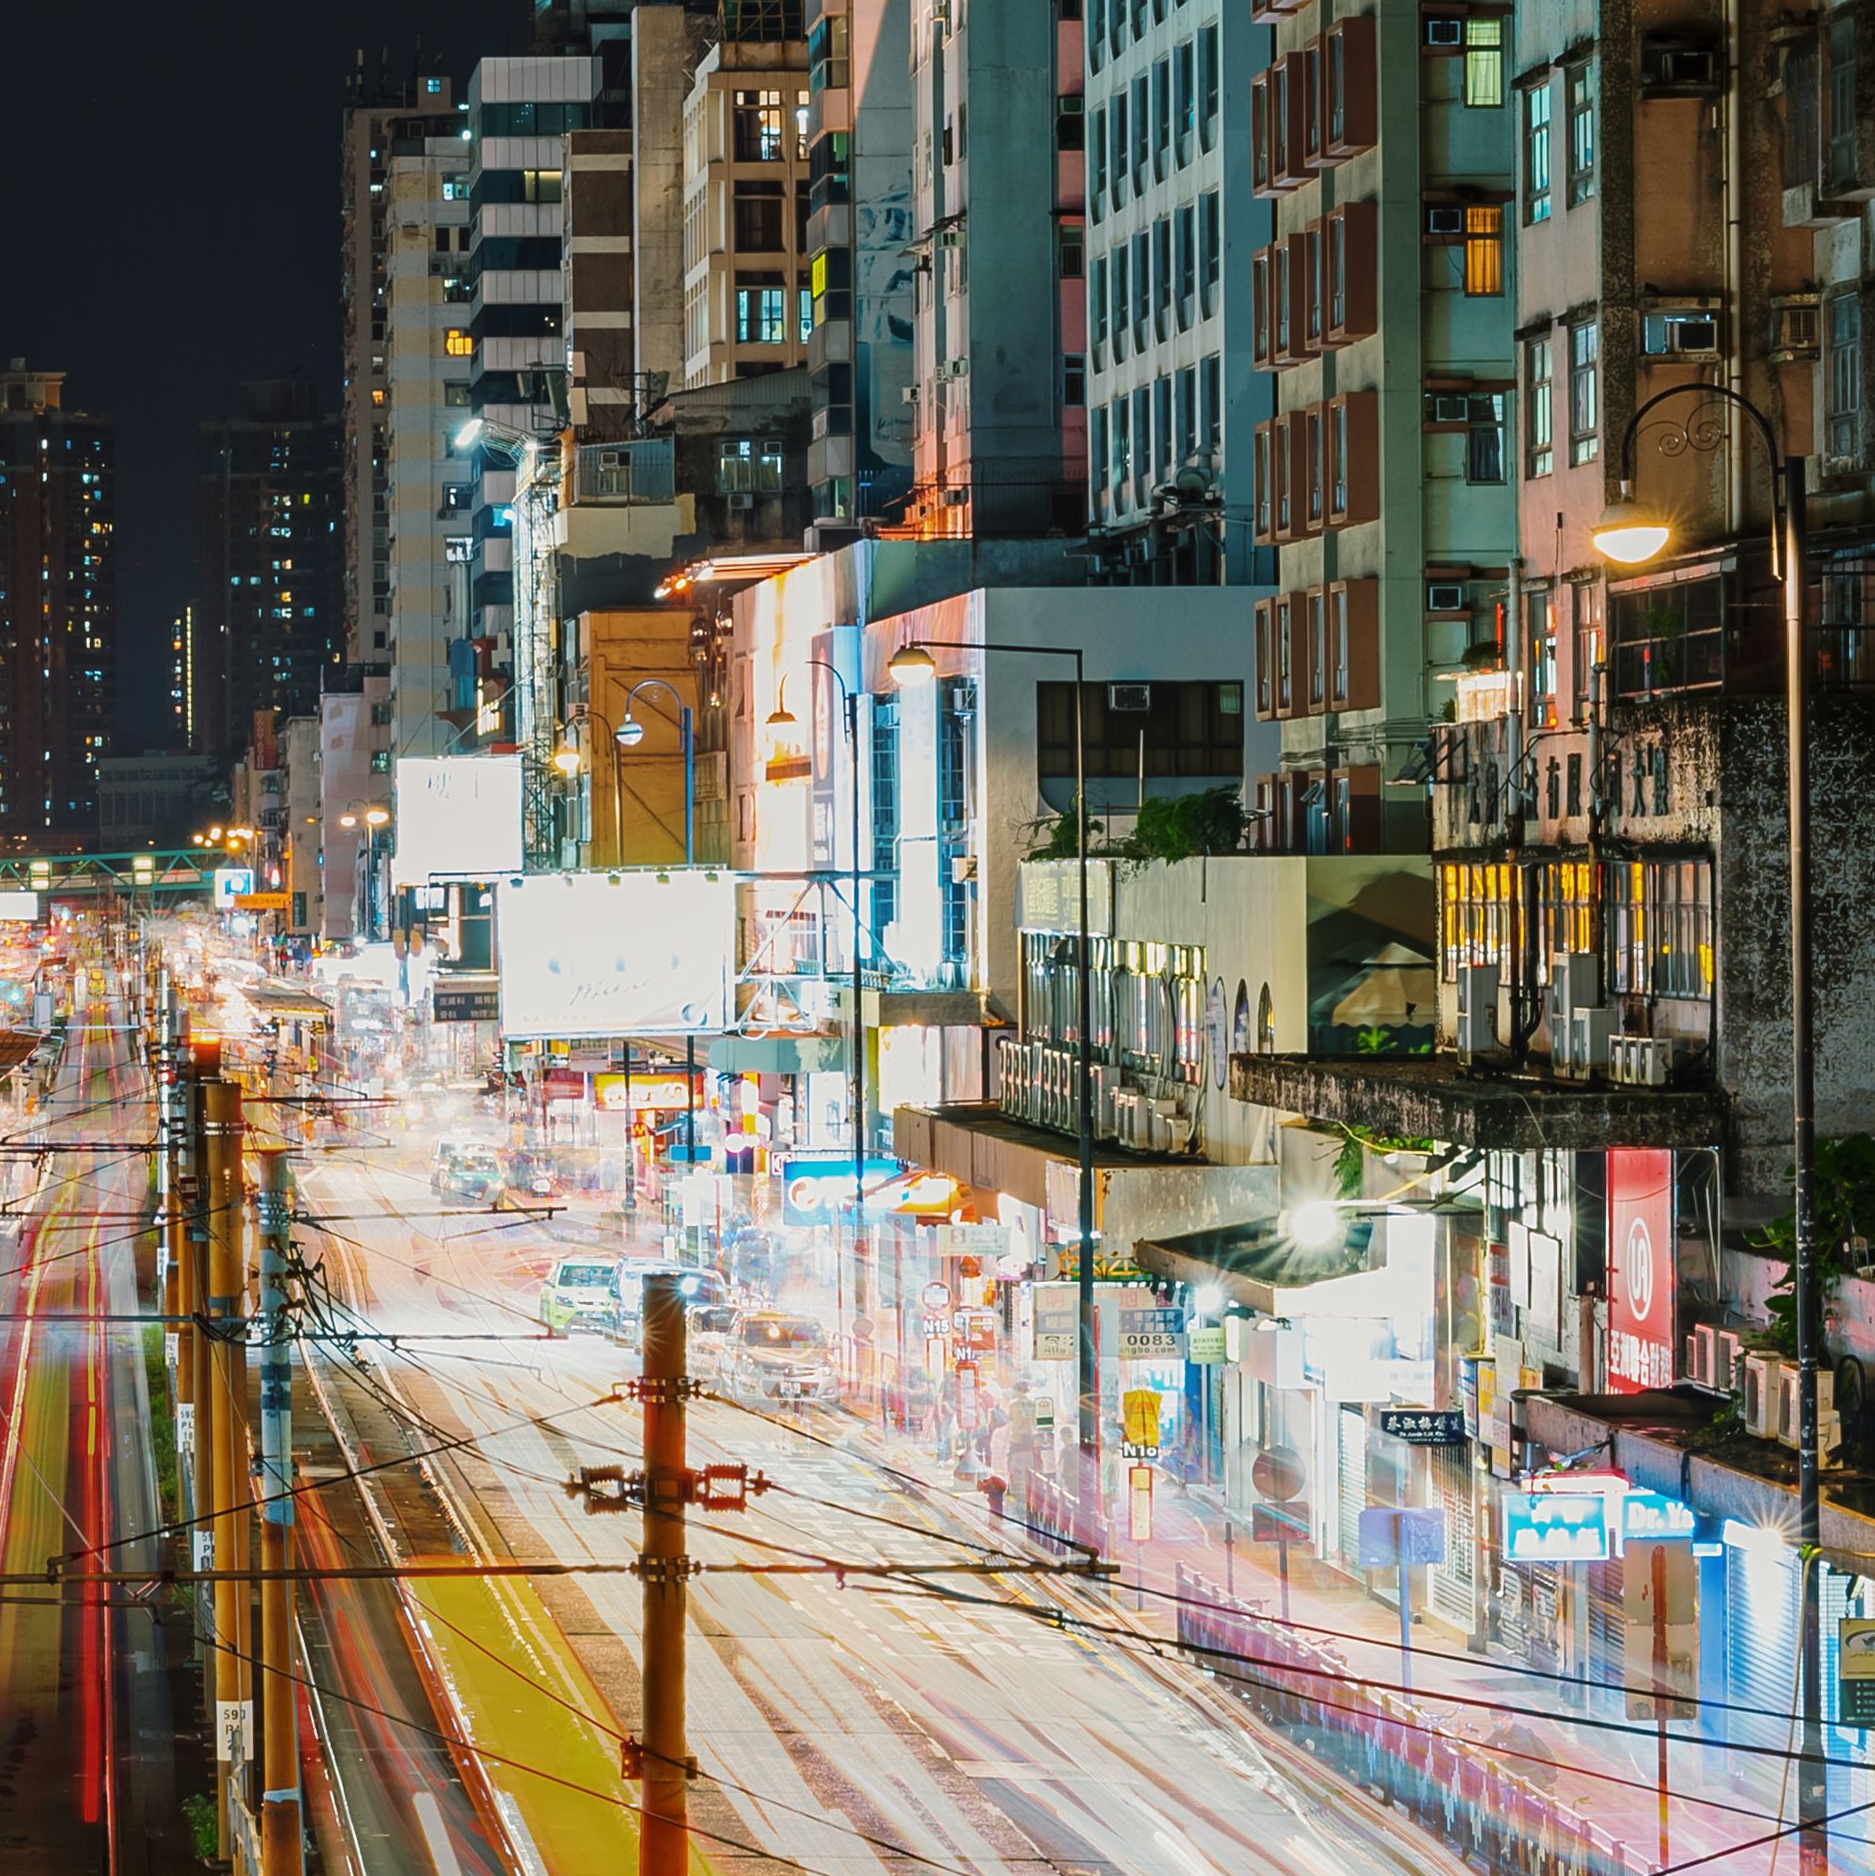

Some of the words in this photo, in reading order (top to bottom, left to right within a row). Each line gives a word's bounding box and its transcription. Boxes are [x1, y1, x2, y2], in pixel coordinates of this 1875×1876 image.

[1127, 1334, 1176, 1346] 0083
[1628, 1502, 1663, 1530] Dr.
[224, 1709, 245, 1720] 590
